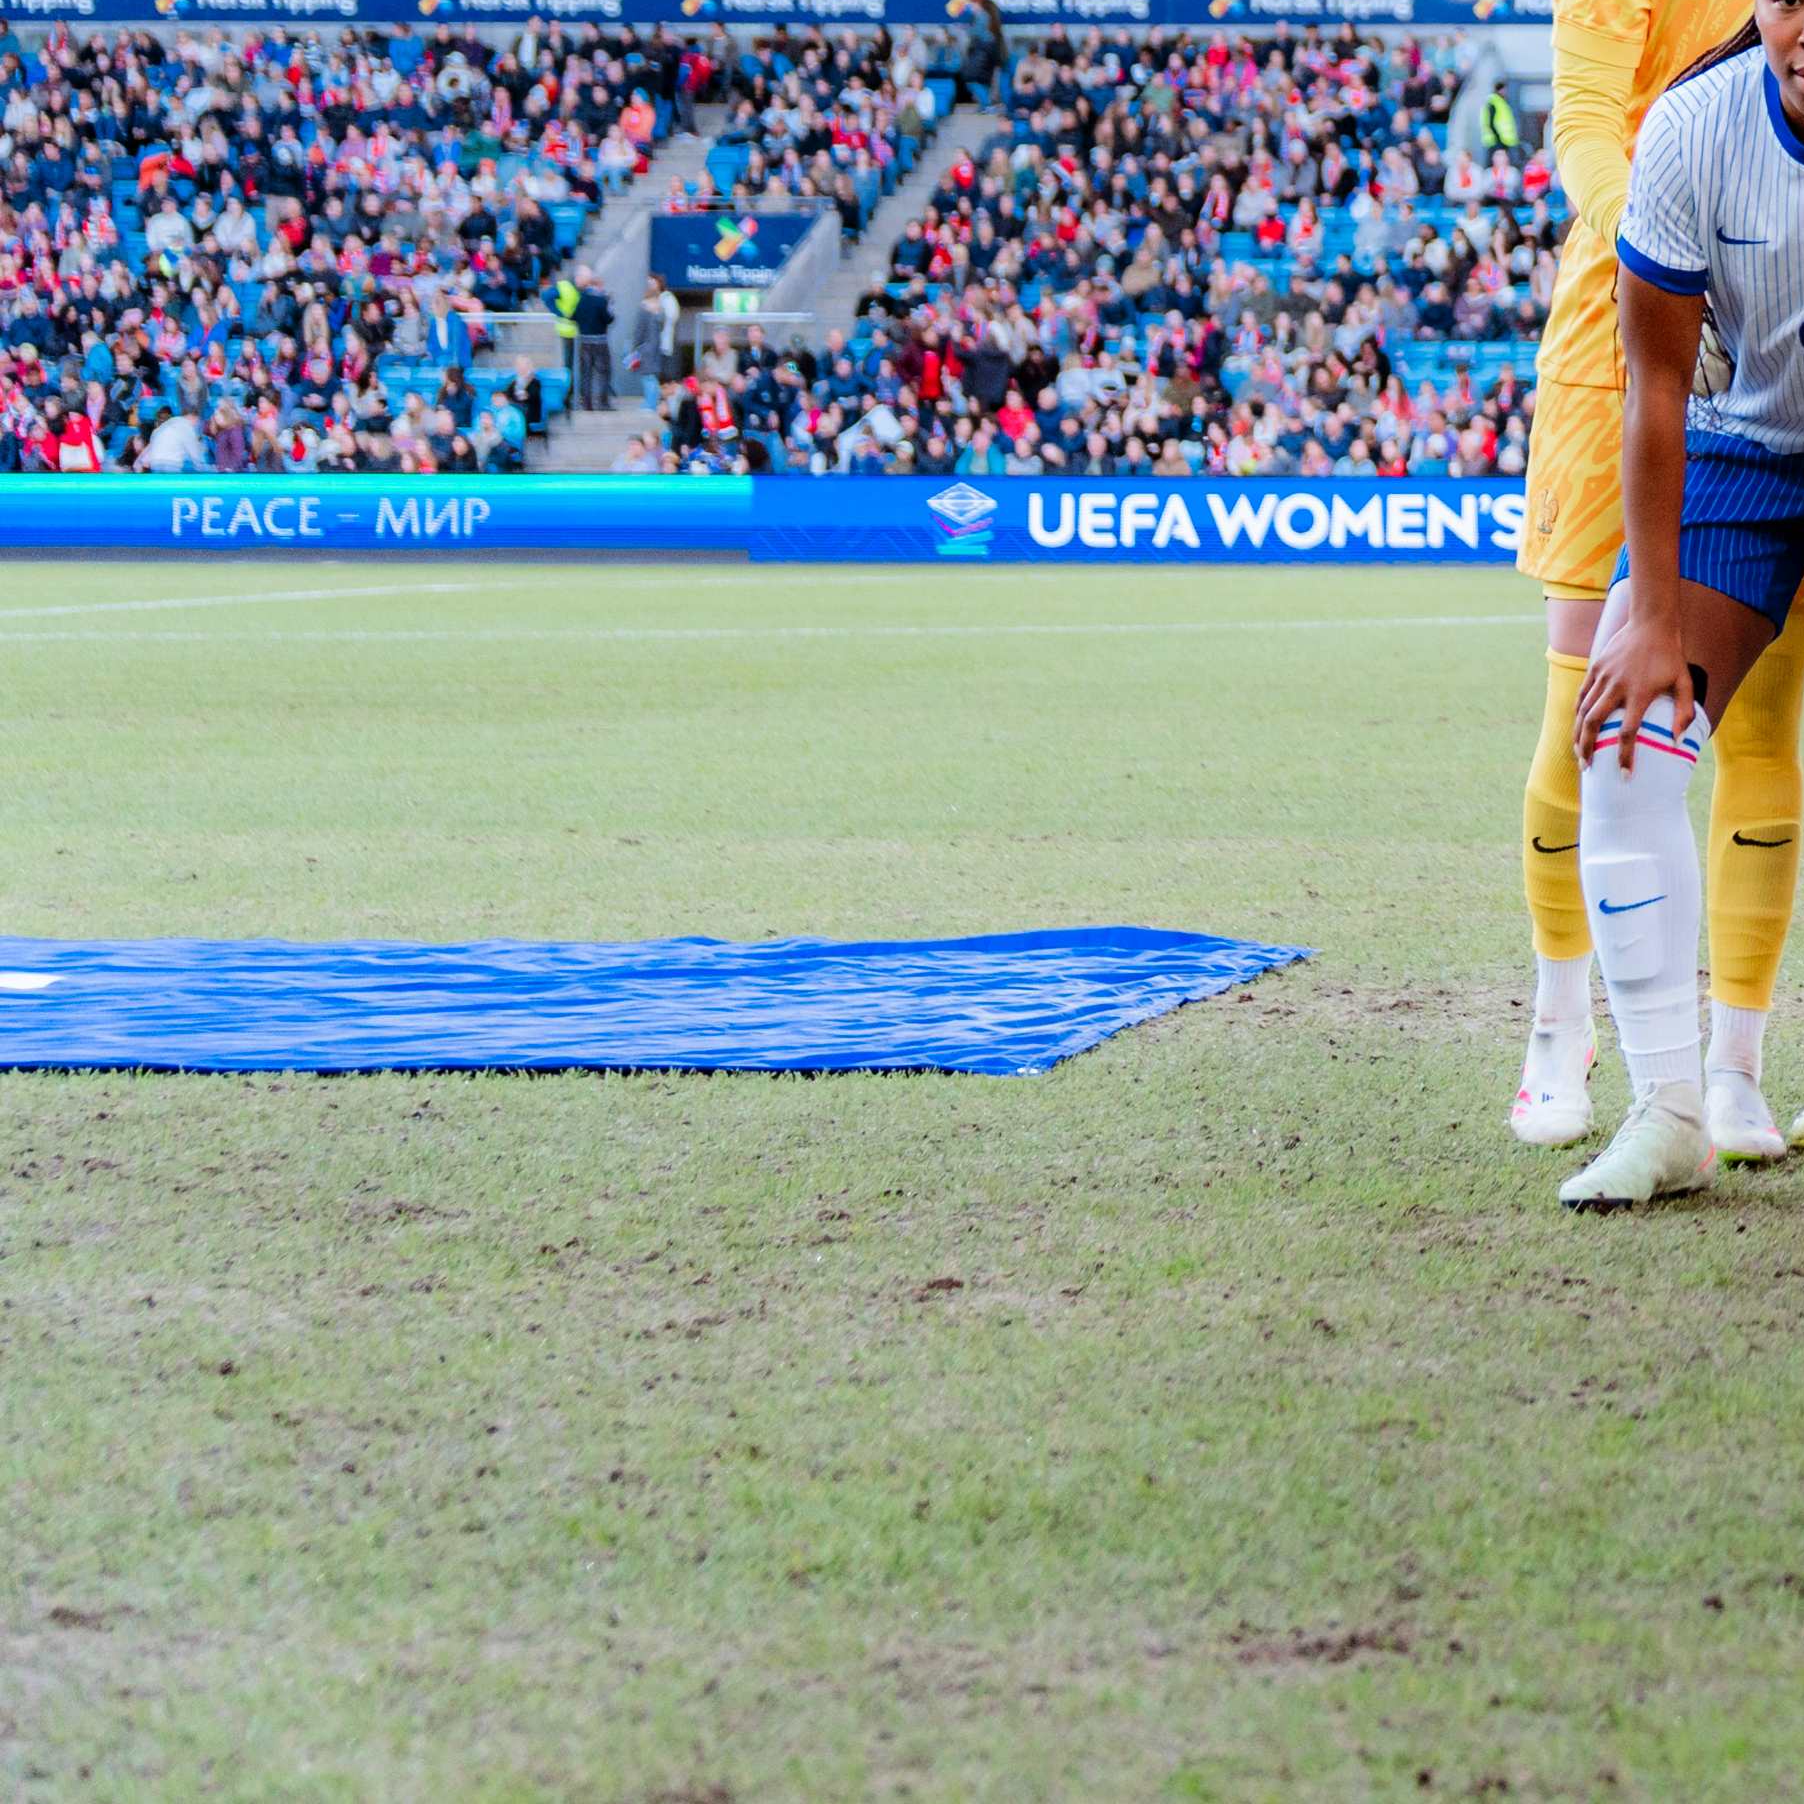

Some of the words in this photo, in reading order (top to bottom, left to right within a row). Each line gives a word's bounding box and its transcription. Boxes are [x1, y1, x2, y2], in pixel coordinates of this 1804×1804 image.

[687, 265, 728, 284] Norsk
[171, 497, 323, 539] PEACE
[376, 497, 490, 538] МИР
[1028, 492, 1200, 549] UEFA
[1205, 492, 1526, 550] WOMEN'S
